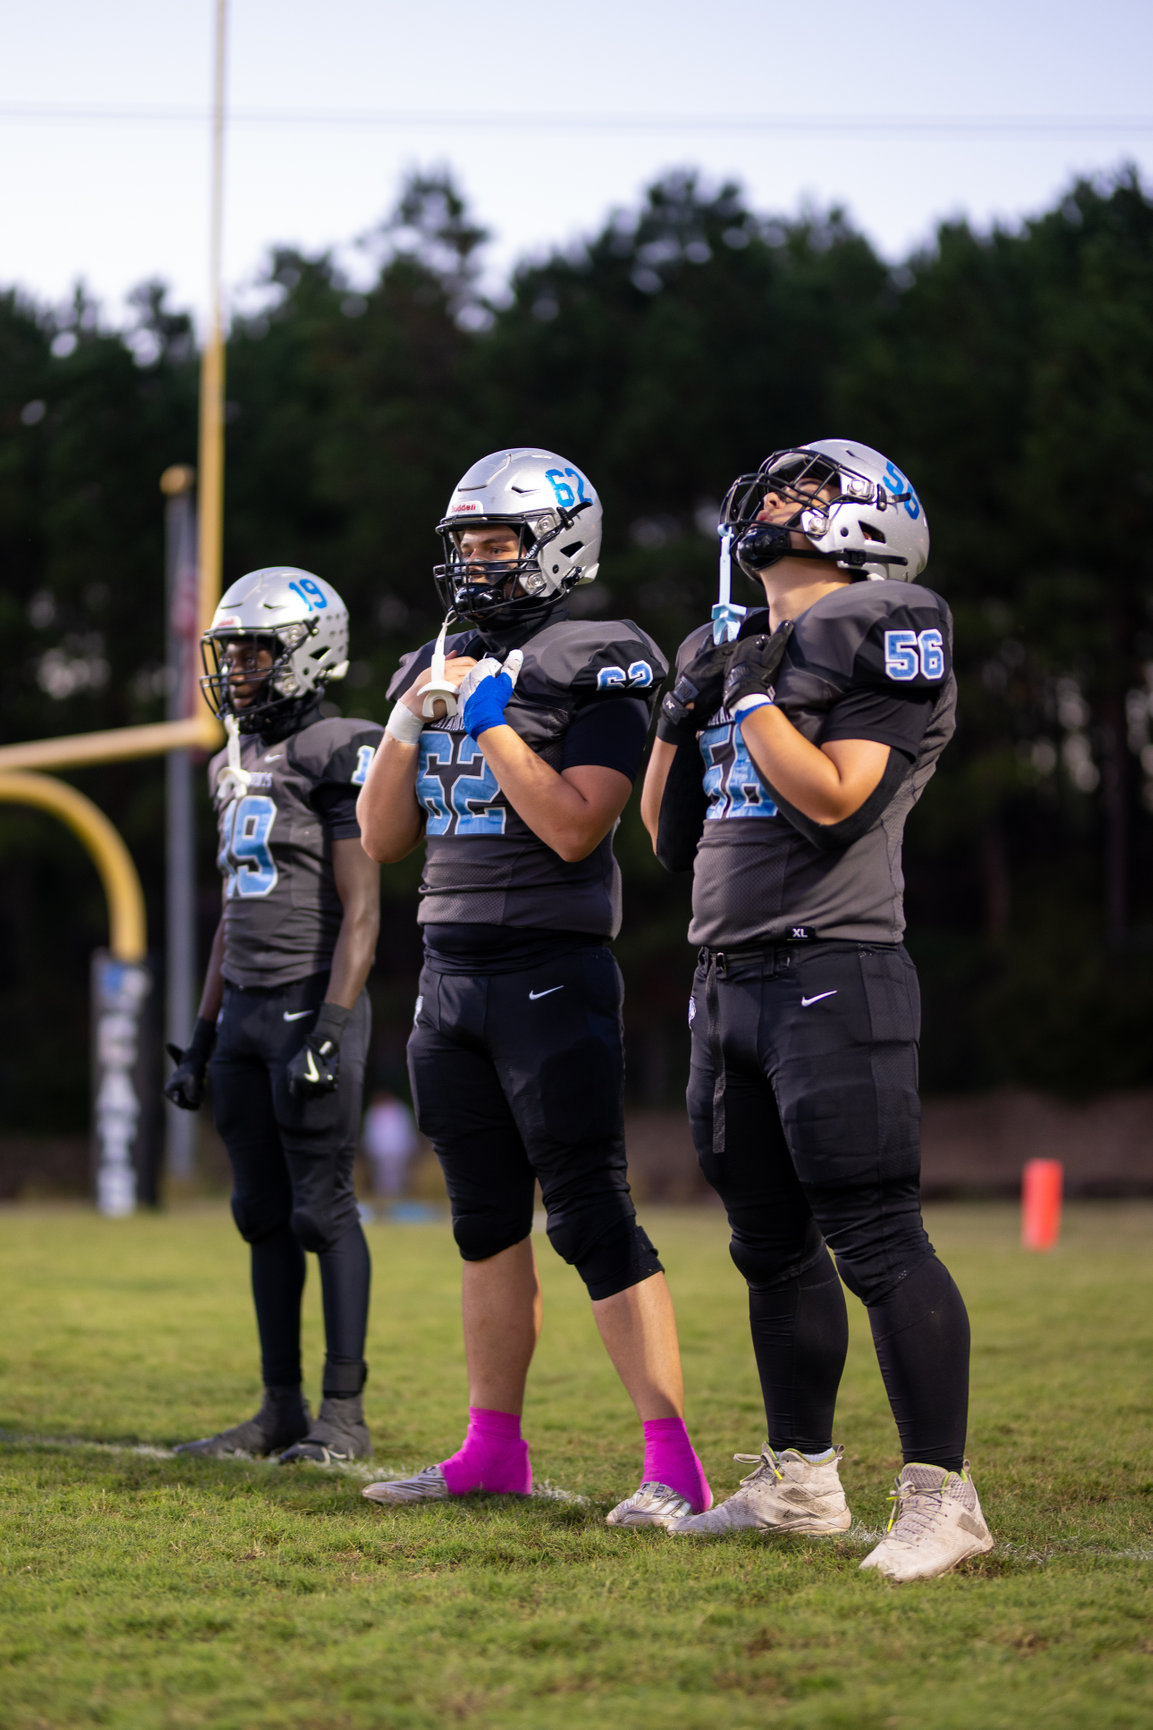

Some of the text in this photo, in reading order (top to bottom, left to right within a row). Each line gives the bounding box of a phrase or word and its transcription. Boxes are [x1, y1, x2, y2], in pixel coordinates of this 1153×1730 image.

[545, 467, 593, 508] 62
[288, 578, 328, 612] 19
[596, 659, 654, 691] 62
[884, 628, 945, 682] 56
[351, 744, 376, 785] 1
[416, 730, 507, 836] 62
[218, 795, 279, 898] 19
[792, 928, 809, 938] XL
